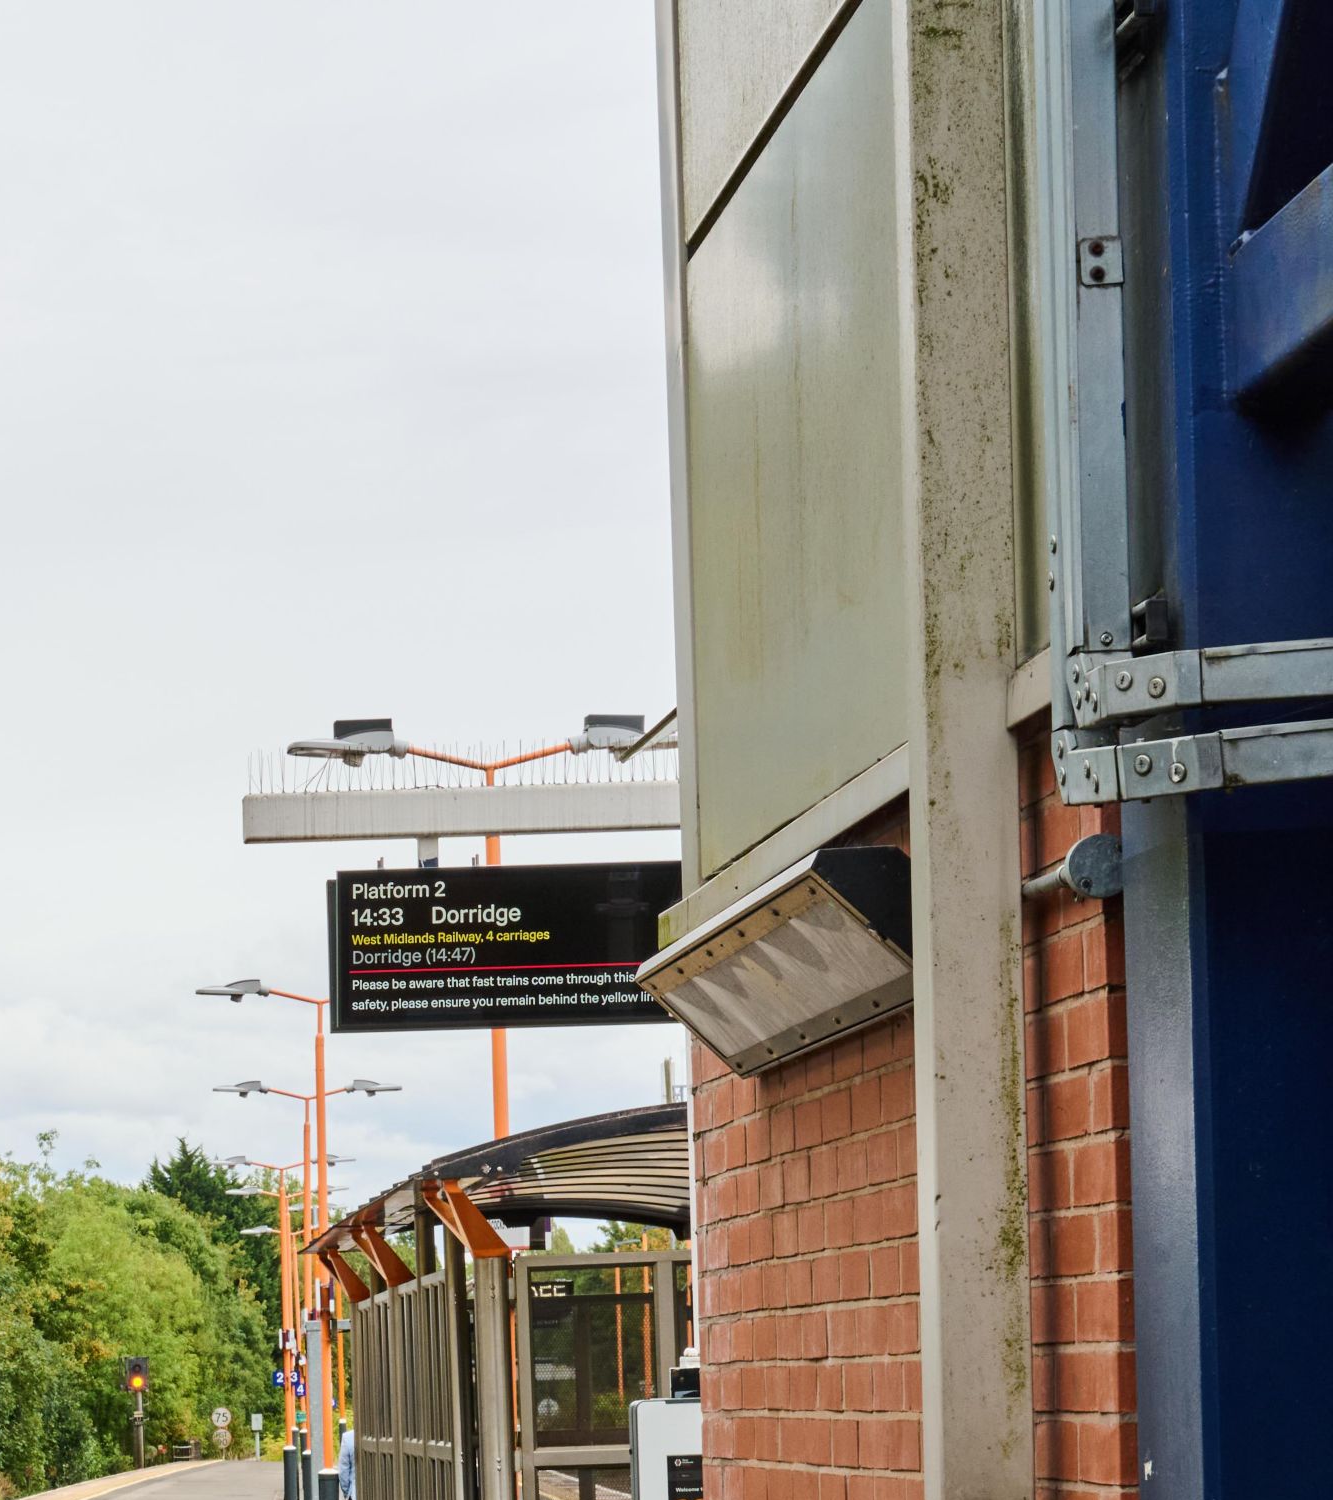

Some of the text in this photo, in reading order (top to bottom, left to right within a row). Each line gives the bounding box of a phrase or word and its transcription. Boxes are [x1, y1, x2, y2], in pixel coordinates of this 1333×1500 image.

[352, 881, 446, 899] Platform 2
[351, 904, 521, 927] 14:33 Dorridge
[352, 929, 550, 945] West Midlands Railway, 4 carriages
[352, 947, 476, 966] Dorridge (14:47)
[352, 971, 635, 990] Please be aware that fast trains come through this
[352, 991, 654, 1012] safety, please ensure you remain behind the yellow lin
[276, 1372, 284, 1383] 2
[290, 1371, 298, 1382] 3
[296, 1384, 305, 1393] 4
[215, 1412, 228, 1423] 75
